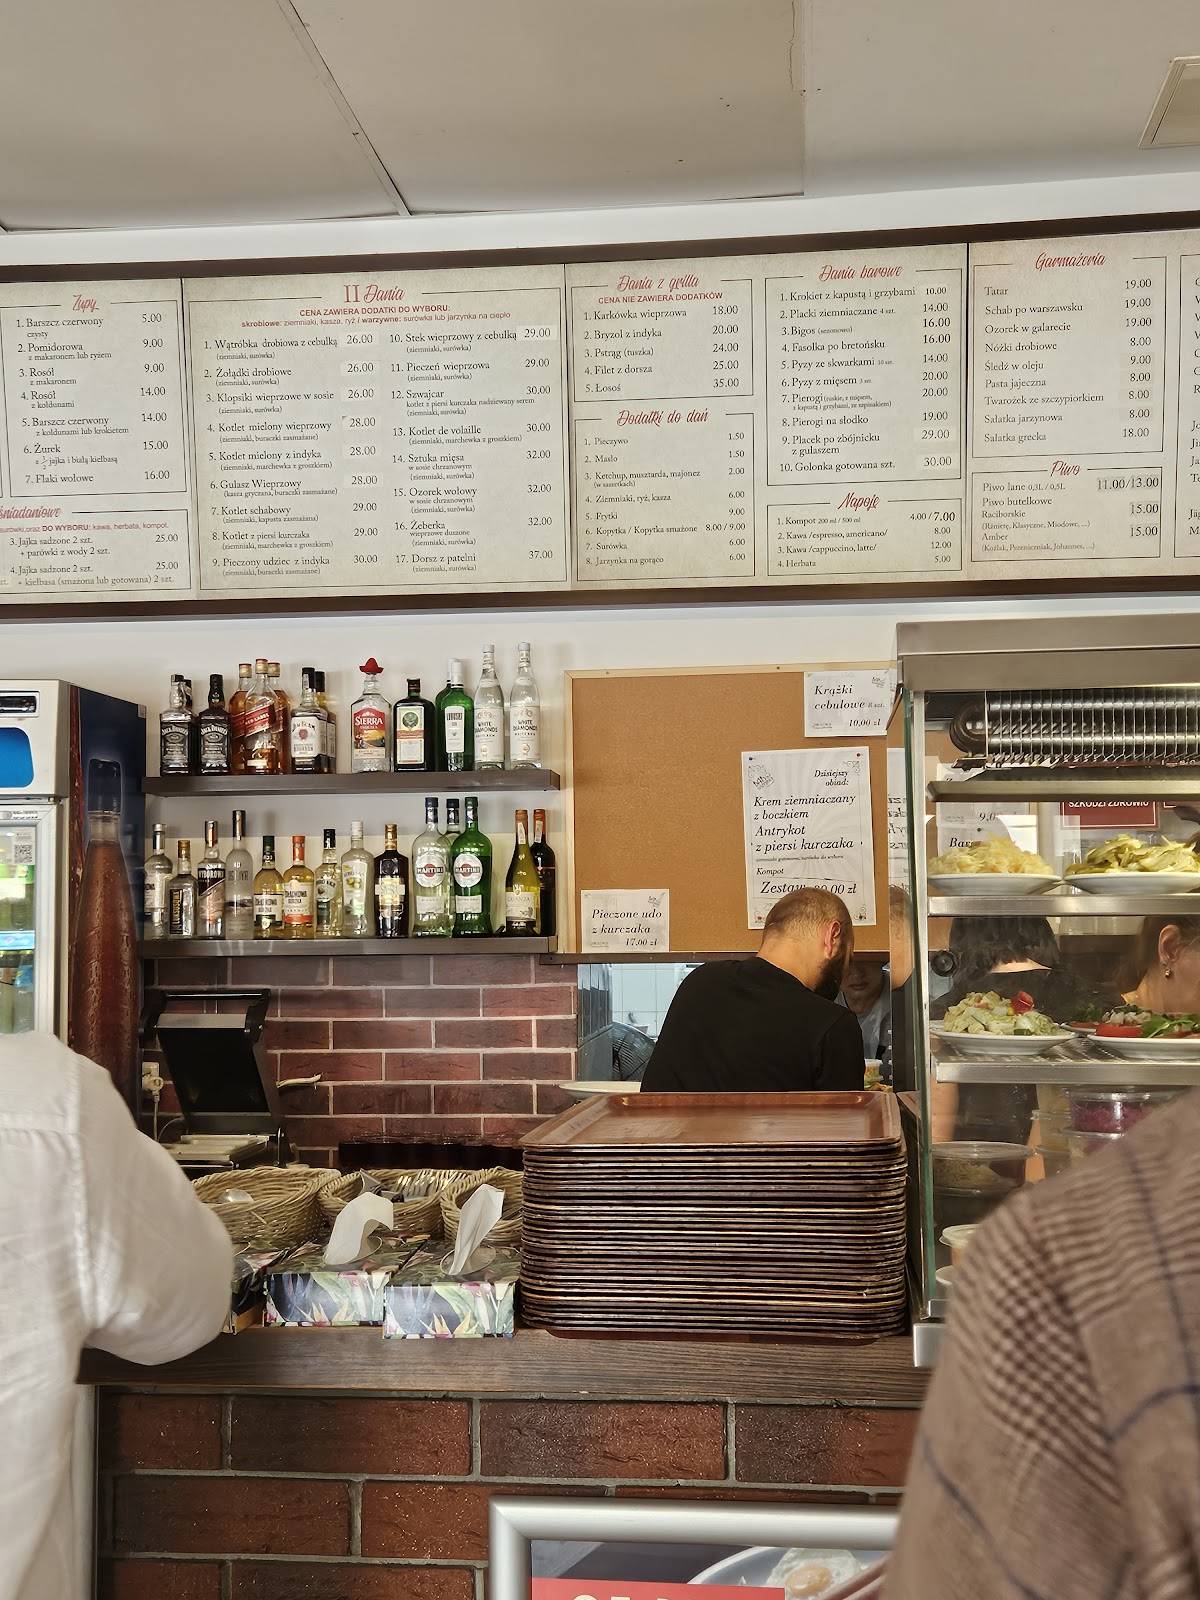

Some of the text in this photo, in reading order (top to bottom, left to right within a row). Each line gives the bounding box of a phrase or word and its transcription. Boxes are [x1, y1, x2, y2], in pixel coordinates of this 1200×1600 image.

[819, 264, 904, 282] Dania barowe
[617, 275, 652, 292] Dania
[984, 278, 1152, 296] Tatar 19.00
[637, 294, 673, 303] ZAWIERA
[676, 292, 723, 301] DODATKÓW
[323, 308, 360, 316] ZAWIERA
[361, 307, 396, 315] DODATKI
[594, 305, 739, 320] Karkówka wieprzowa 18.00
[790, 302, 948, 319] Placki ziemniaczane 14.00
[985, 298, 1151, 317] Schab po warszawsku 19.00
[26, 313, 162, 327] Barszcz czerwony 5.00
[791, 317, 951, 337] Bigos 16.00
[594, 330, 623, 342] Bryzol
[633, 328, 662, 339] indyka
[712, 324, 739, 335] 20.00
[28, 338, 164, 352] Pomidorowa 9.00
[792, 333, 951, 353] Fasolka po bretońsku 16.00
[985, 337, 1151, 353] Nóżki drobiowe 8.00
[595, 343, 739, 360] Pstrąg (tuszka) 24.00
[406, 358, 550, 372] Pieczeń wieprzowa 29.00
[595, 365, 615, 375] Filet
[624, 364, 653, 374] dorsza
[713, 360, 739, 370] 25.00
[792, 359, 813, 370] Pyzy
[828, 358, 875, 368] skwarkami
[923, 353, 948, 363] 14.00
[984, 355, 1151, 371] Śledź w oleju 9.00
[985, 372, 1151, 390] Pasta jajeczna 8.00
[406, 386, 551, 400] Szwajcar 30.00
[792, 387, 948, 405] Pierogi 20.00
[32, 412, 167, 427] Barszcz czerwony 14.00
[667, 411, 681, 423] do
[687, 408, 709, 423] dań
[218, 417, 376, 434] Kotlet mielony wieprzowy 28.00
[409, 423, 551, 436] Kotlet de volaille 30.00
[34, 440, 169, 454] Żurek 15.00
[594, 432, 745, 448] Pieczywo 1.50
[219, 452, 246, 461] Kotlet
[249, 451, 282, 462] mielony
[293, 450, 322, 461] indyka
[350, 445, 376, 455] 28.00
[408, 450, 551, 464] Sztuka mięsa 32.00
[794, 457, 952, 472] Golonka gotowana szt. 30.00
[1051, 460, 1081, 477] Piwo
[983, 482, 1004, 492] Piwo
[1007, 481, 1025, 491] lane
[221, 503, 377, 517] Kotlet schabowy 29.00
[982, 496, 1159, 515] Piwo butelkowe 15.00
[596, 508, 745, 522] Frytki 9.00
[410, 516, 552, 531] Żeberka 32.00
[729, 538, 746, 546] 6.00
[814, 684, 853, 698] Krążki
[814, 699, 865, 711] cebulowe
[355, 717, 383, 726] SIERRA
[814, 769, 848, 779] Dzisiejszy
[826, 778, 849, 787] obiad:
[754, 794, 856, 807] Krem ziemniaczany
[762, 808, 809, 820] boczkiem
[755, 824, 806, 837] Antrykot
[755, 838, 854, 854] z piersi kurczaka
[416, 866, 444, 874] MARTINI
[455, 866, 481, 874] MARTINI
[756, 867, 784, 876] Kompot
[592, 909, 662, 919] Pieczone udo
[601, 924, 651, 934] kurczaka
